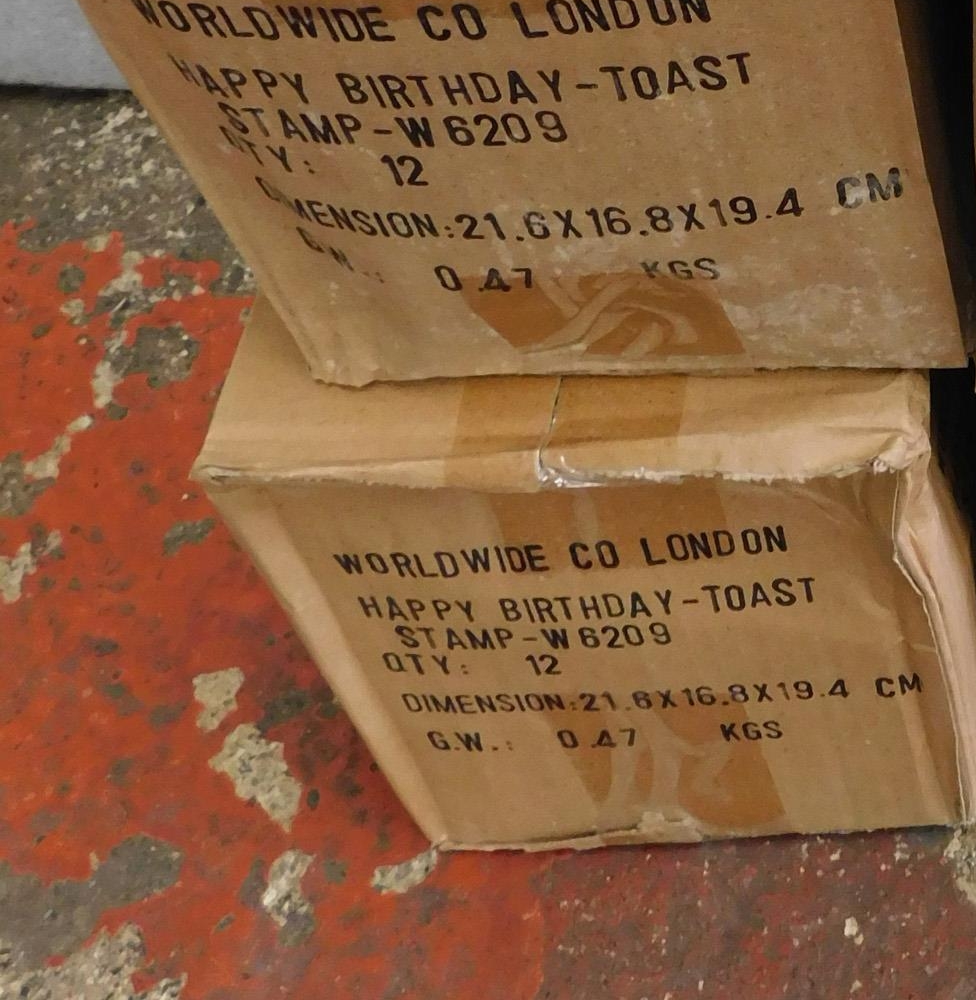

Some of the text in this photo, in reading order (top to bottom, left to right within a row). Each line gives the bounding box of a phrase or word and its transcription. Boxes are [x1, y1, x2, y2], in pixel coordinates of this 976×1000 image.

[420, 5, 486, 43] CO
[168, 53, 309, 104] HAPPY
[381, 155, 429, 186] 12
[835, 167, 903, 209] CM
[639, 257, 721, 280] KGS
[333, 525, 789, 579] WORLDWIDE CO LONDON
[358, 596, 474, 623] HAPPY
[382, 652, 562, 676] QTY: 12
[875, 671, 924, 698] CM
[719, 720, 784, 743] KGS
